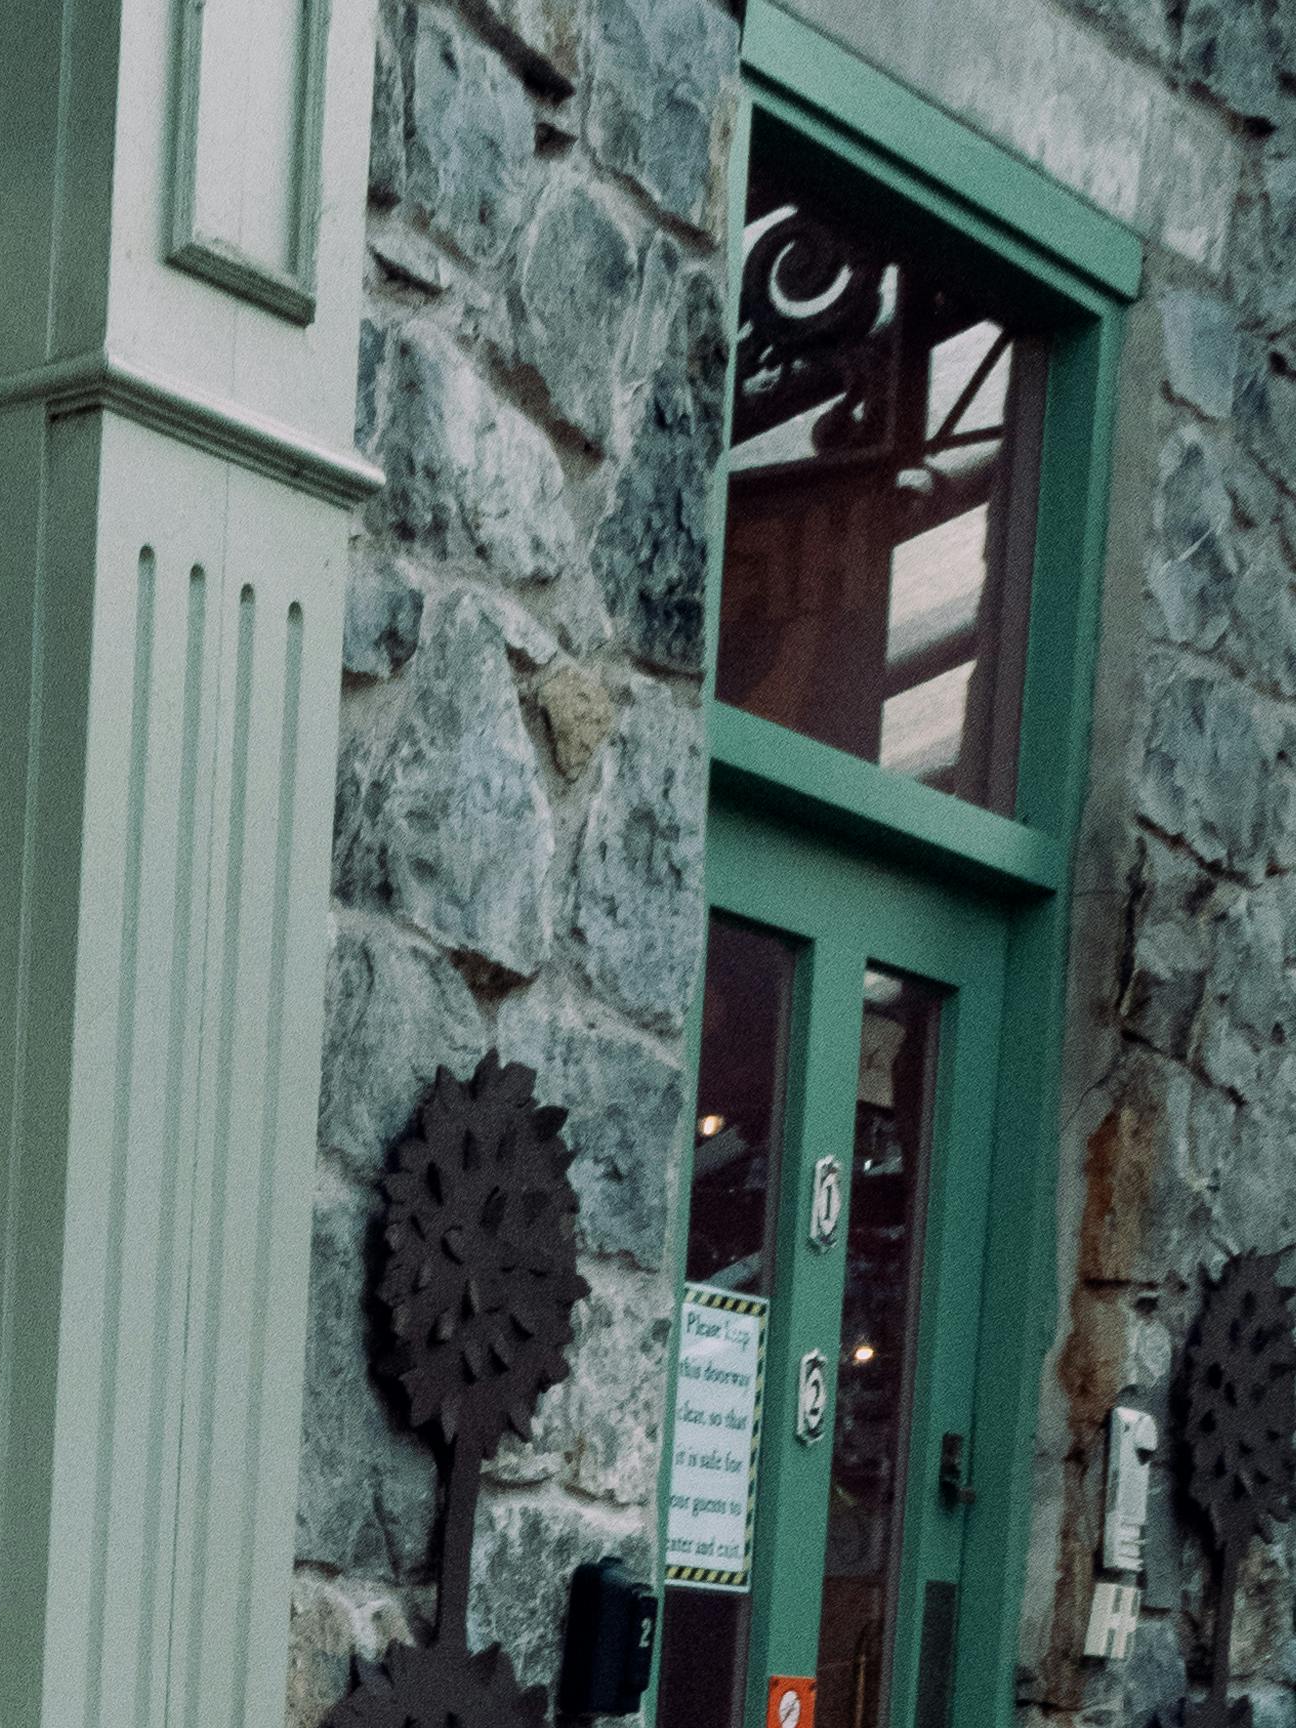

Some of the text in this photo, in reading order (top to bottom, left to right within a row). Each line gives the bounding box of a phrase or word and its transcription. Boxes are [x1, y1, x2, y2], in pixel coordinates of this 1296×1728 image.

[687, 1312, 720, 1337] Please
[680, 1357, 751, 1391] this doorway
[709, 1412, 723, 1427] so
[726, 1410, 747, 1431] that
[688, 1449, 698, 1466] is
[700, 1448, 721, 1468] safe
[725, 1450, 742, 1472] for
[692, 1497, 726, 1517] guests
[730, 1499, 741, 1515] to
[696, 1539, 714, 1555] and
[639, 1618, 651, 1647] 2
